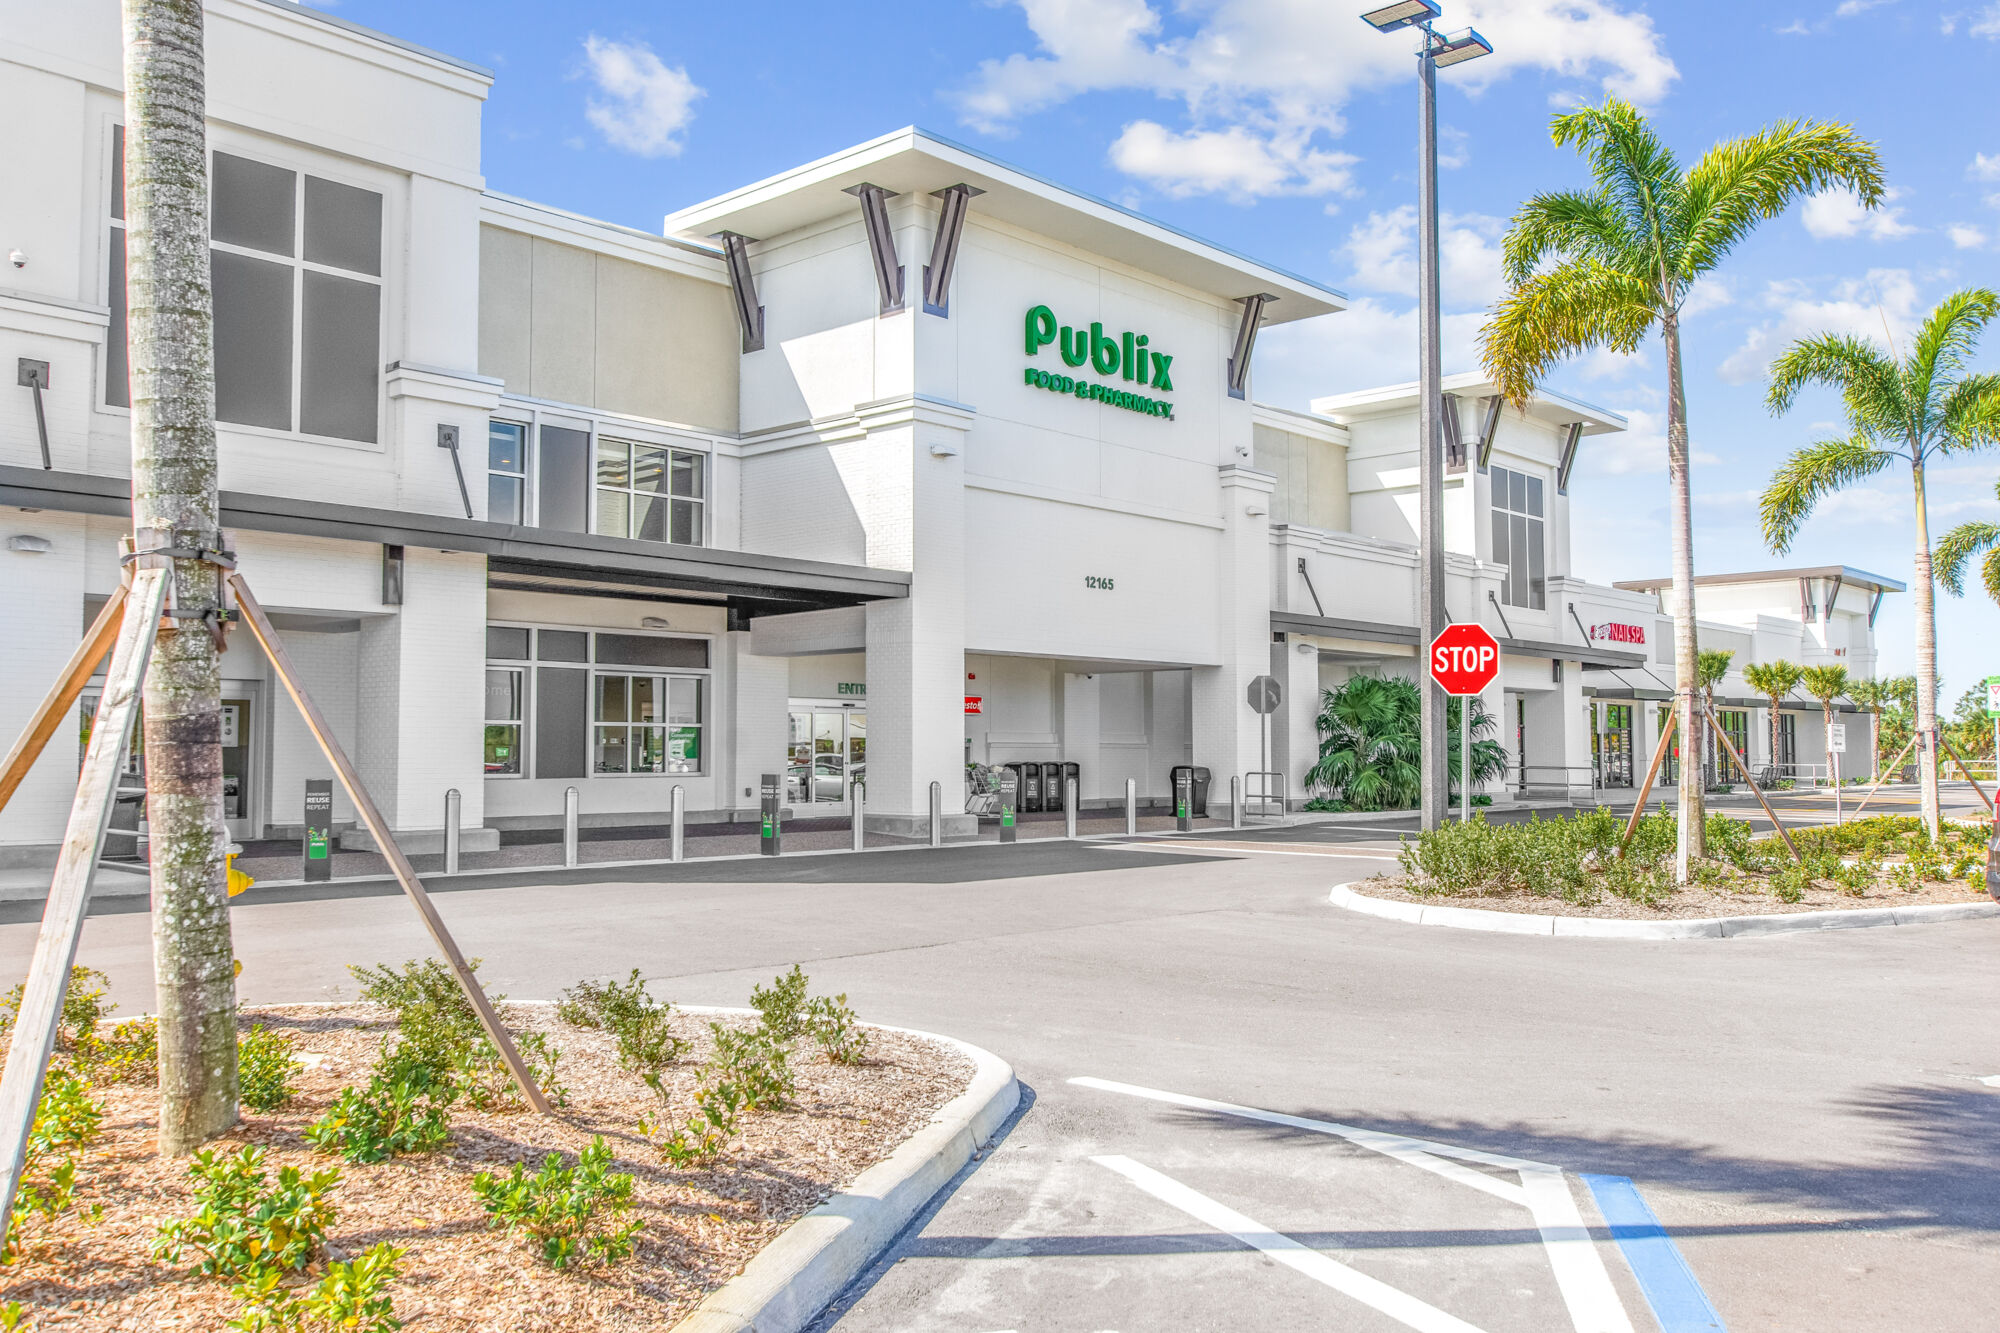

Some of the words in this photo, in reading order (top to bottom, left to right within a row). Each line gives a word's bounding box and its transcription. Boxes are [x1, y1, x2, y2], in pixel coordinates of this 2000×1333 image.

[1025, 305, 1173, 391] Publix
[1025, 368, 1074, 393] FOOD
[1075, 381, 1089, 399] &
[1089, 384, 1173, 418] PHARMACY
[1085, 576, 1114, 590] 12165
[1434, 645, 1495, 673] STOP
